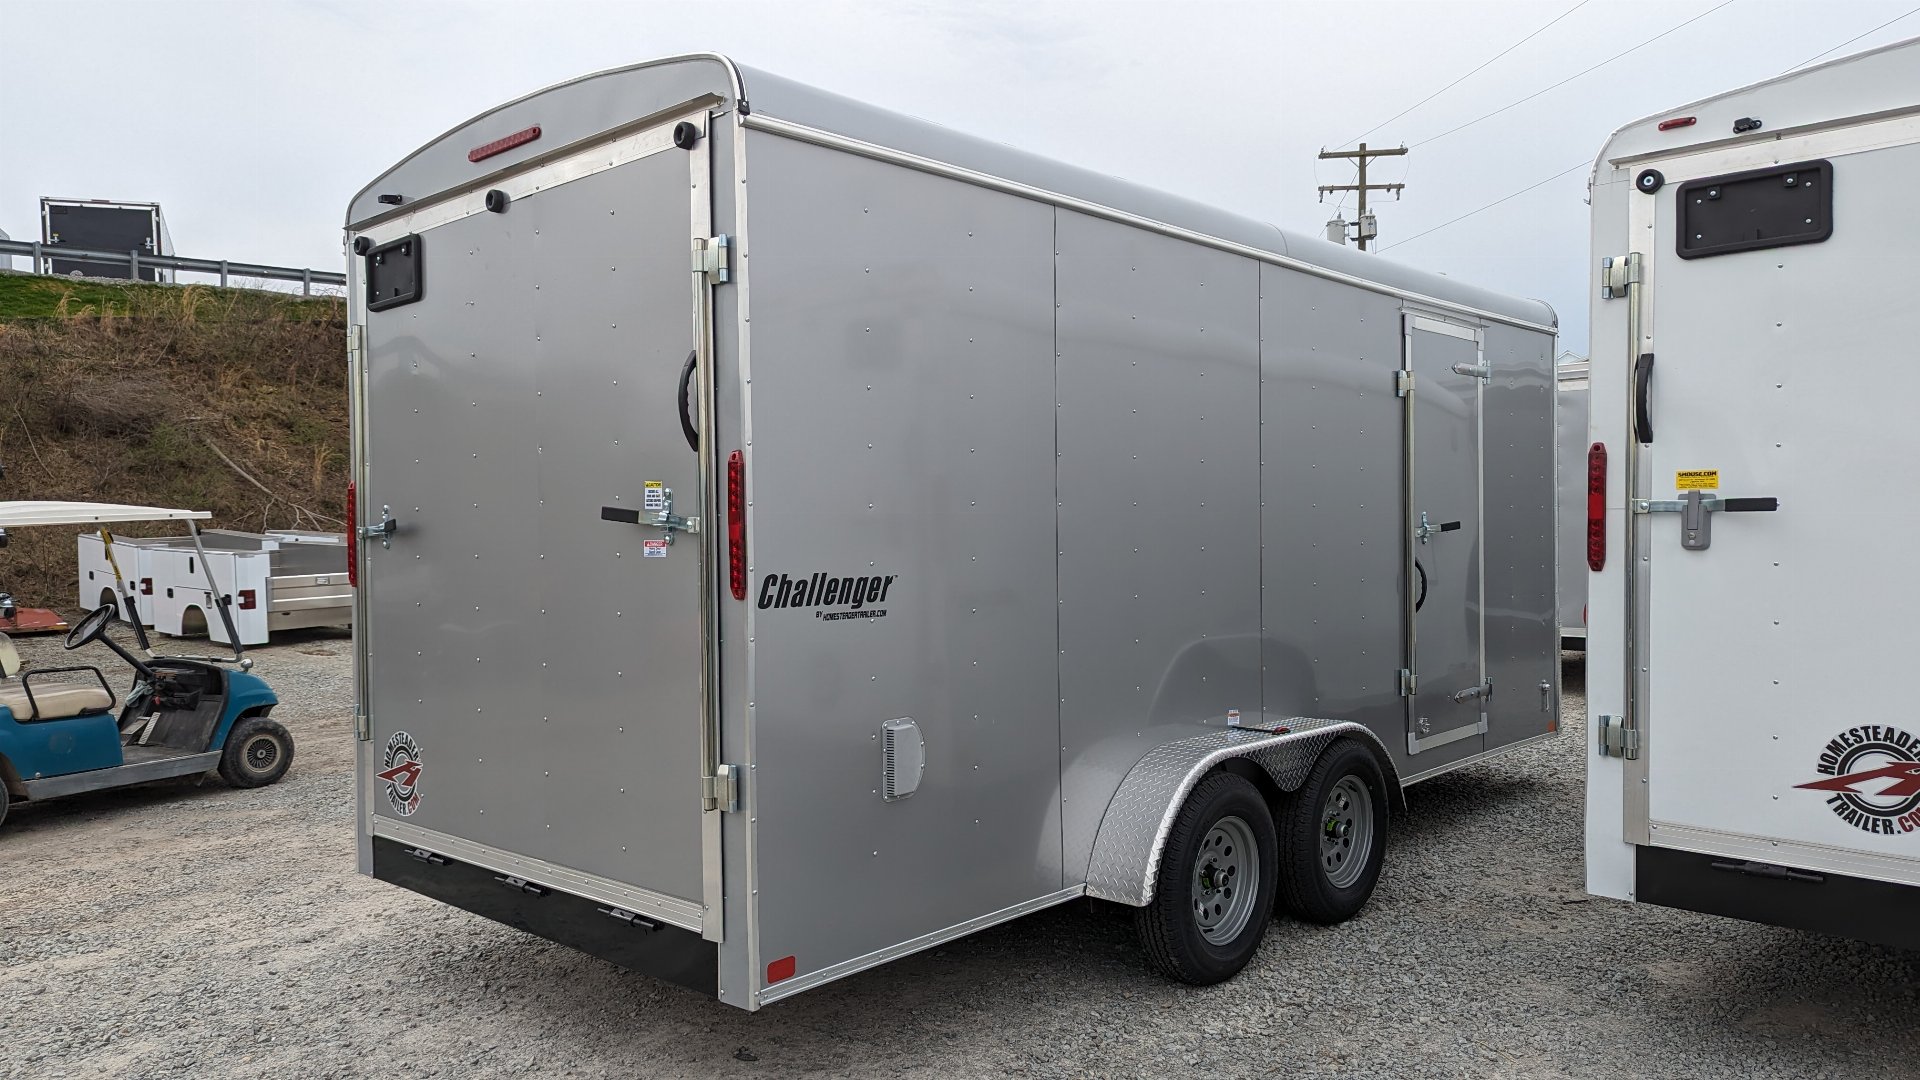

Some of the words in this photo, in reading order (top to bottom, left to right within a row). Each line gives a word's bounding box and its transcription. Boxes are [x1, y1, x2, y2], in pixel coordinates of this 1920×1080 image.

[758, 572, 894, 609] Challenger
[815, 610, 823, 618] BY
[1817, 725, 1920, 776] HOMESTEADE
[1826, 792, 1920, 835] TRAILER.CO
